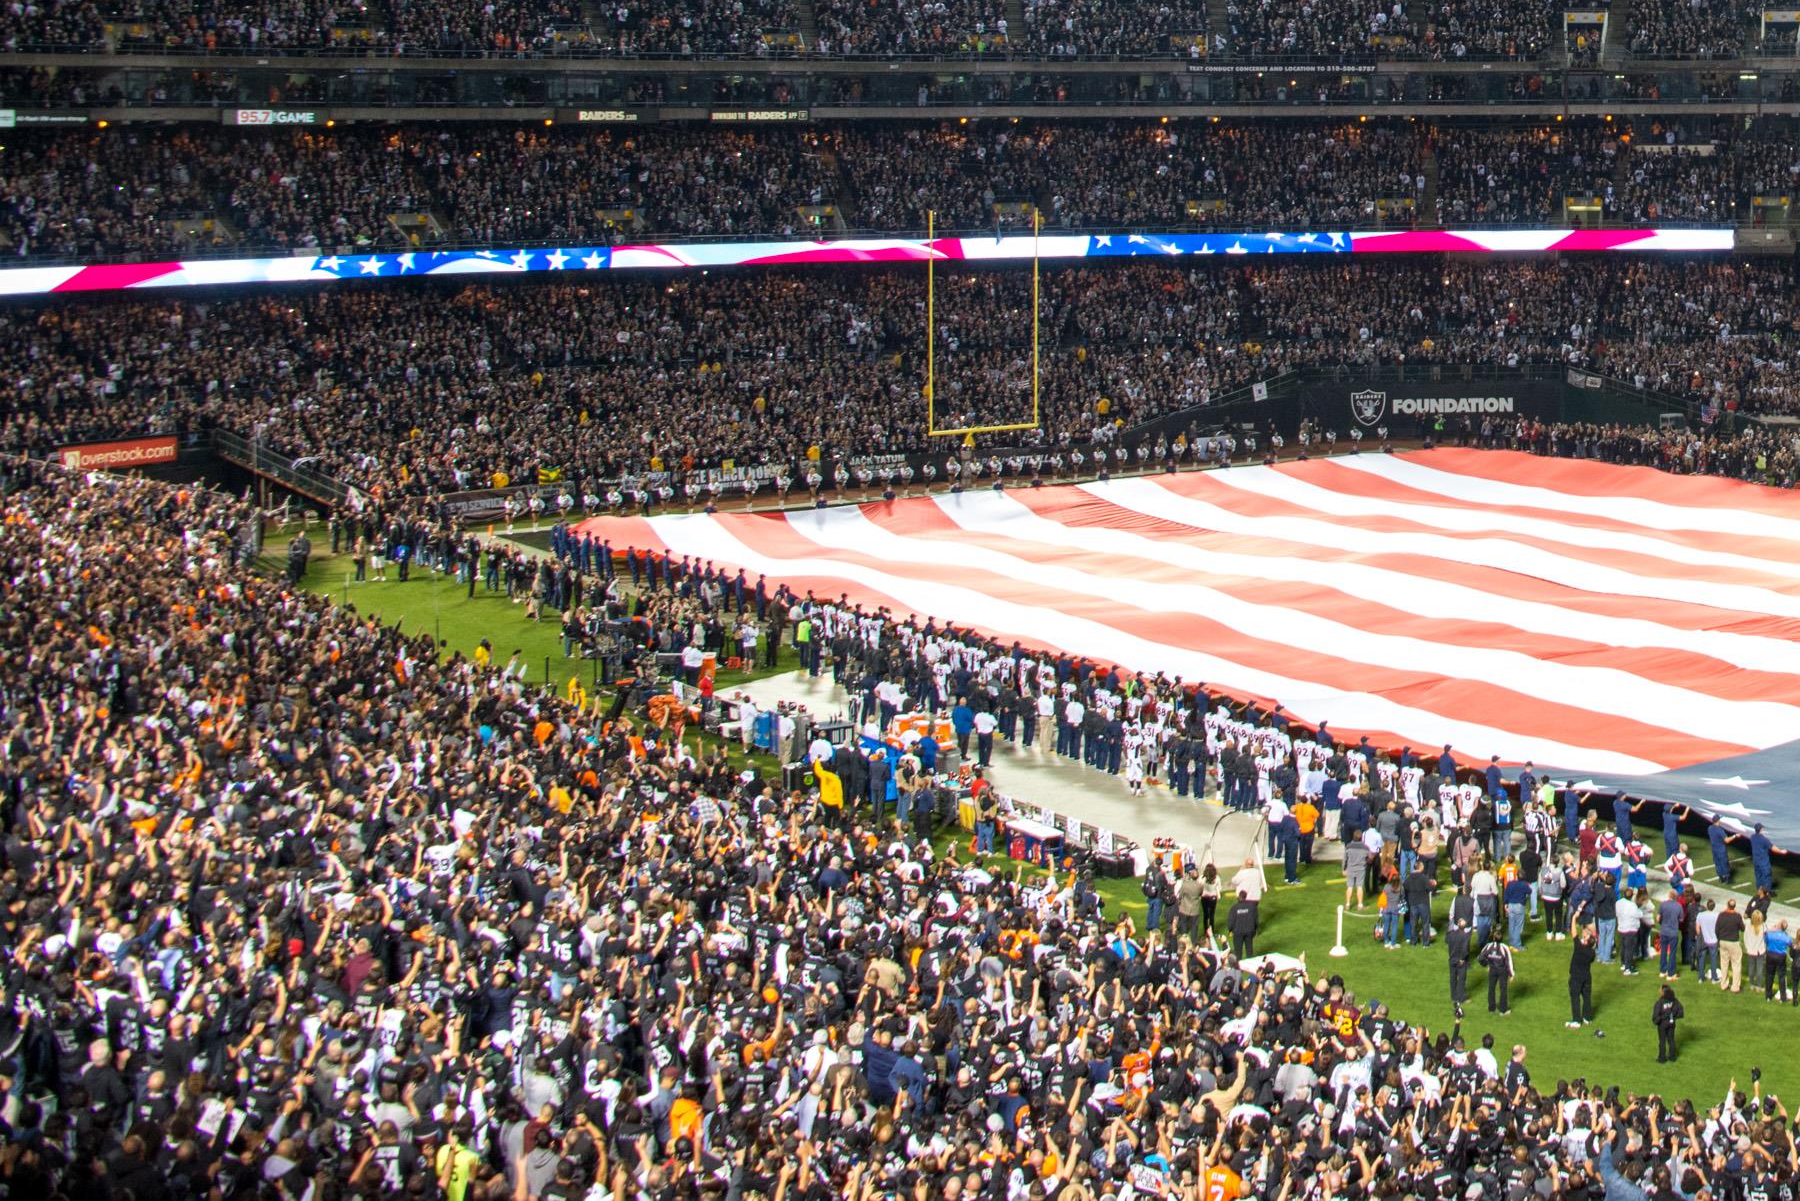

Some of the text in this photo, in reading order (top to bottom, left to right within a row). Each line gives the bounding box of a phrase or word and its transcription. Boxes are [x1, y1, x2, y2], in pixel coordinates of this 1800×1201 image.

[239, 111, 271, 123] 95.7
[276, 111, 315, 123] GAME
[747, 111, 787, 120] RAIDERS
[1392, 397, 1514, 414] FOUNDATION
[81, 444, 175, 466] overstock.com
[849, 453, 906, 466] JACK TATUM
[1465, 791, 1471, 801] 8
